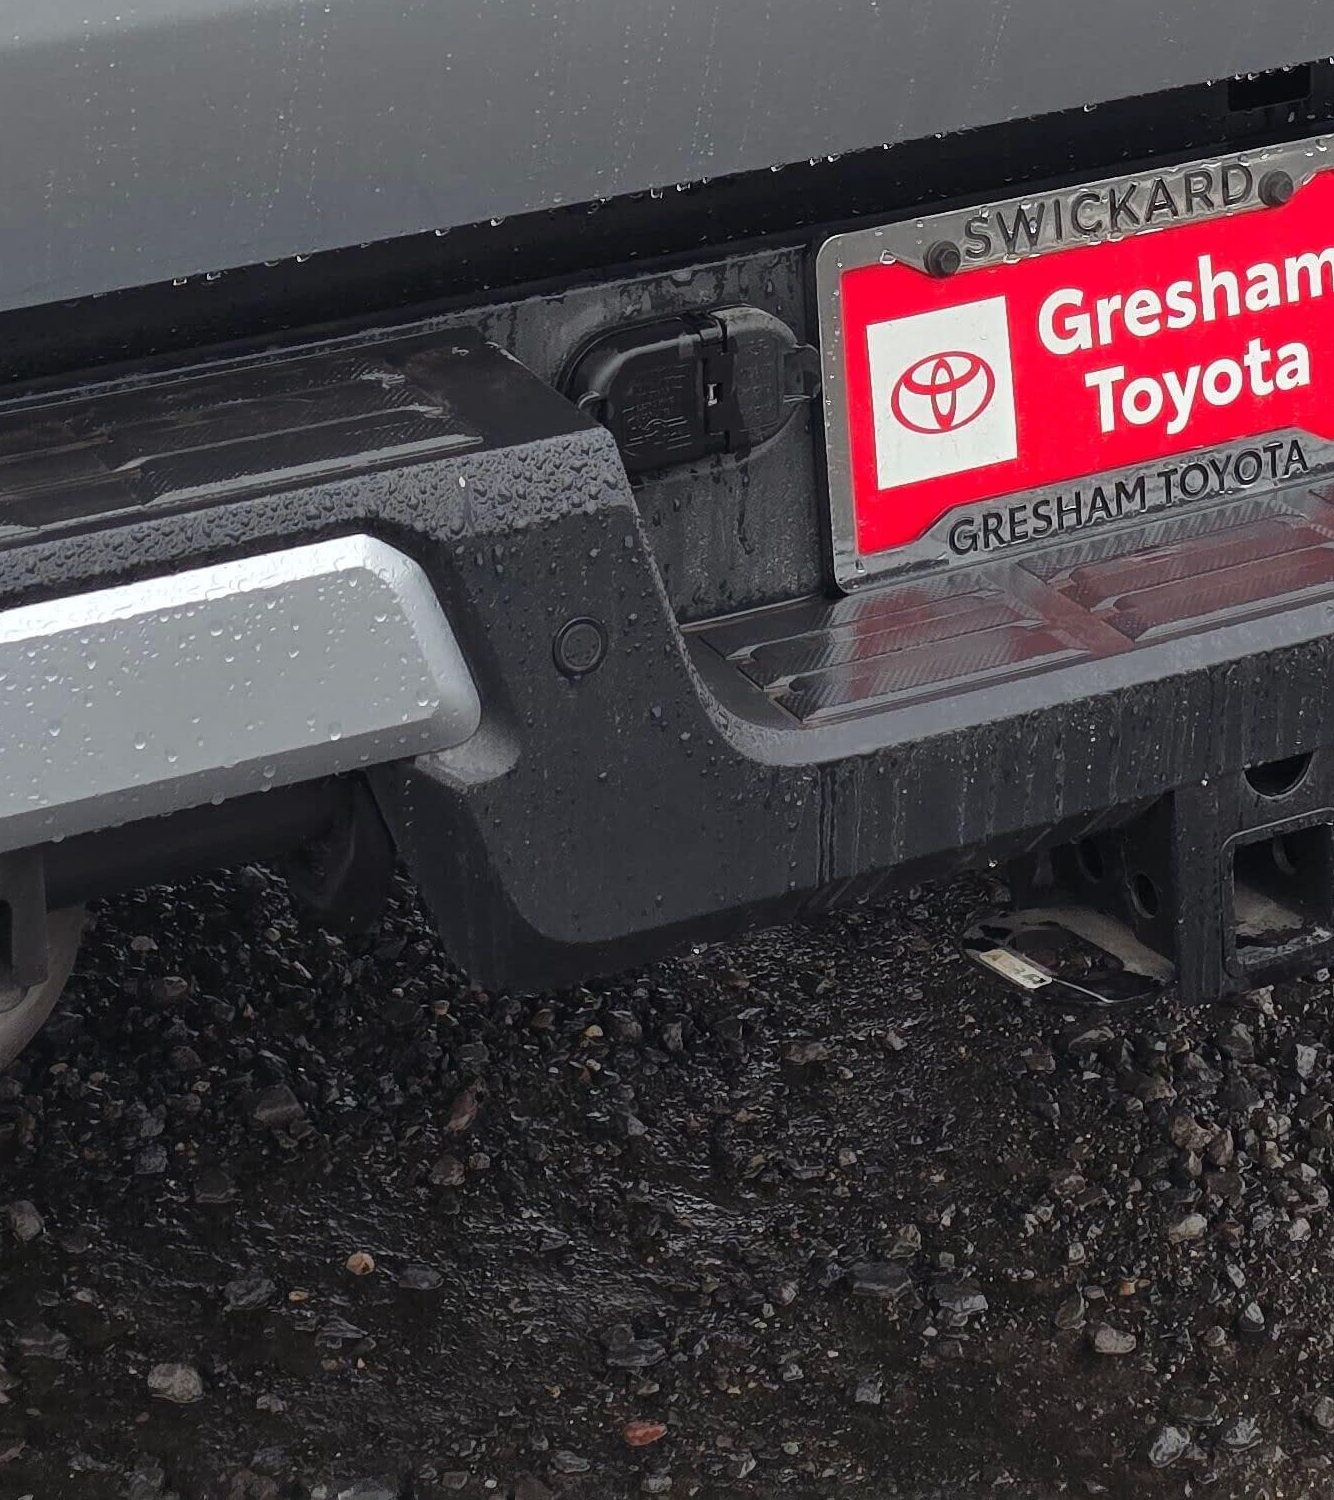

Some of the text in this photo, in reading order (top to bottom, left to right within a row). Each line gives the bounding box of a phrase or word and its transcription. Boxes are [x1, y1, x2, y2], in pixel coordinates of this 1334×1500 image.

[964, 162, 1253, 260] SWICKARD
[1085, 337, 1311, 435] Toyota
[947, 438, 1309, 556] GRESHAM TOYOTA
